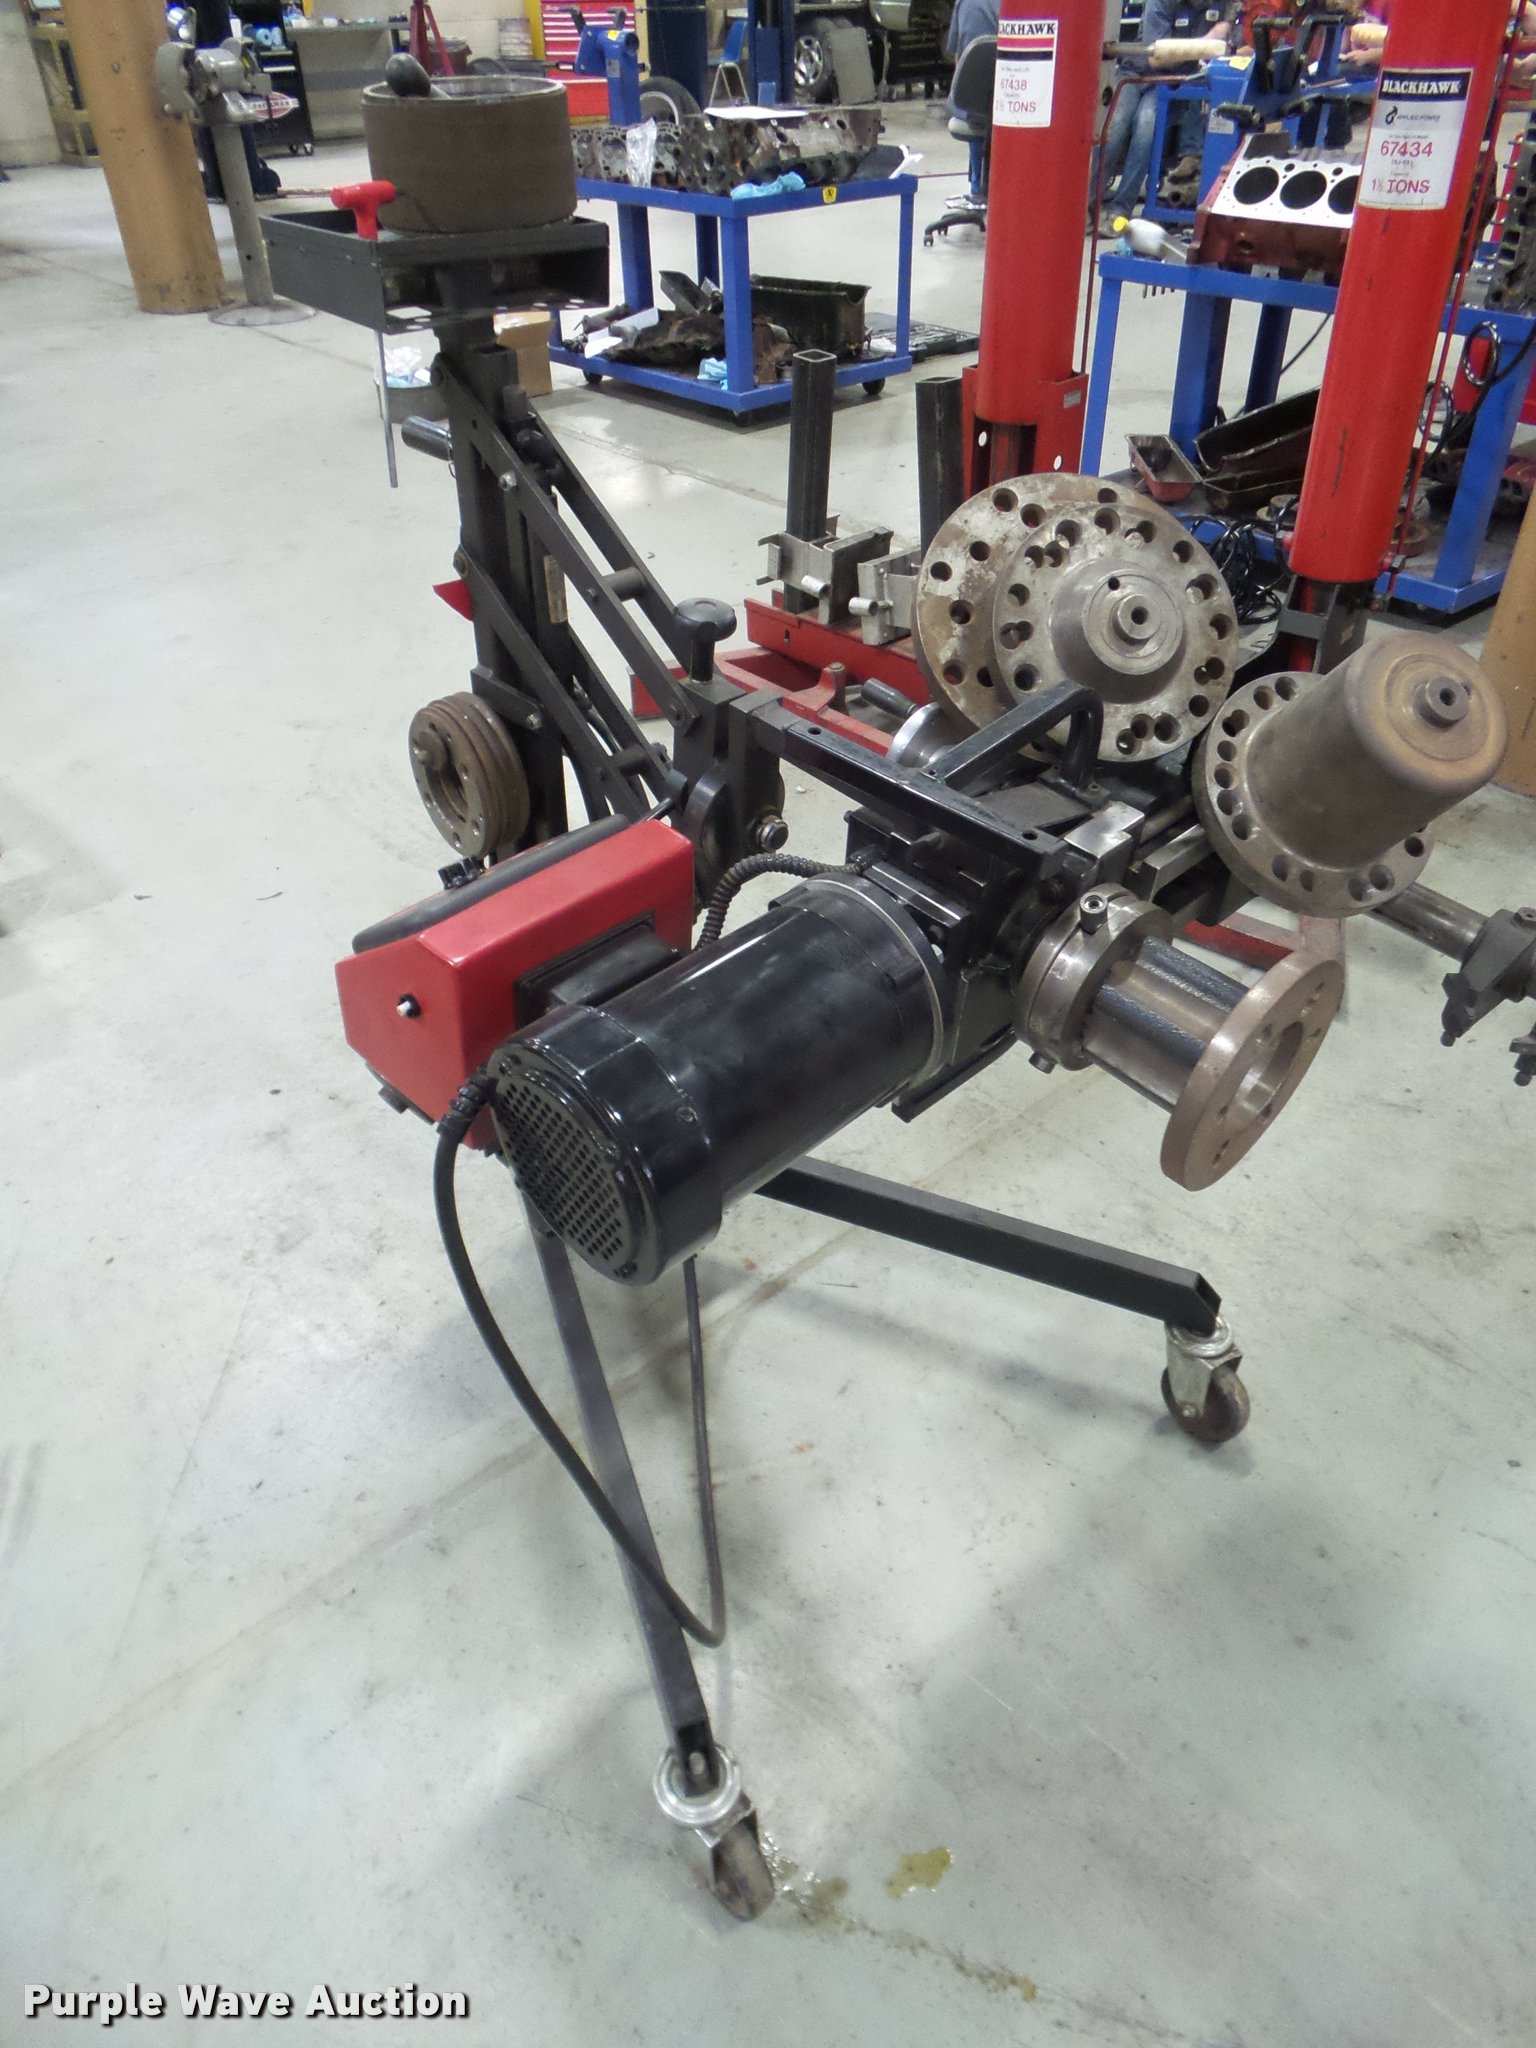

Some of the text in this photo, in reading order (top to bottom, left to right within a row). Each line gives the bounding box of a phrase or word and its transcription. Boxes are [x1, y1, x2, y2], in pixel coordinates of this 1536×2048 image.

[1381, 79, 1461, 95] BLACKHAWK
[1008, 101, 1036, 113] TONS
[1380, 140, 1434, 158] 67434
